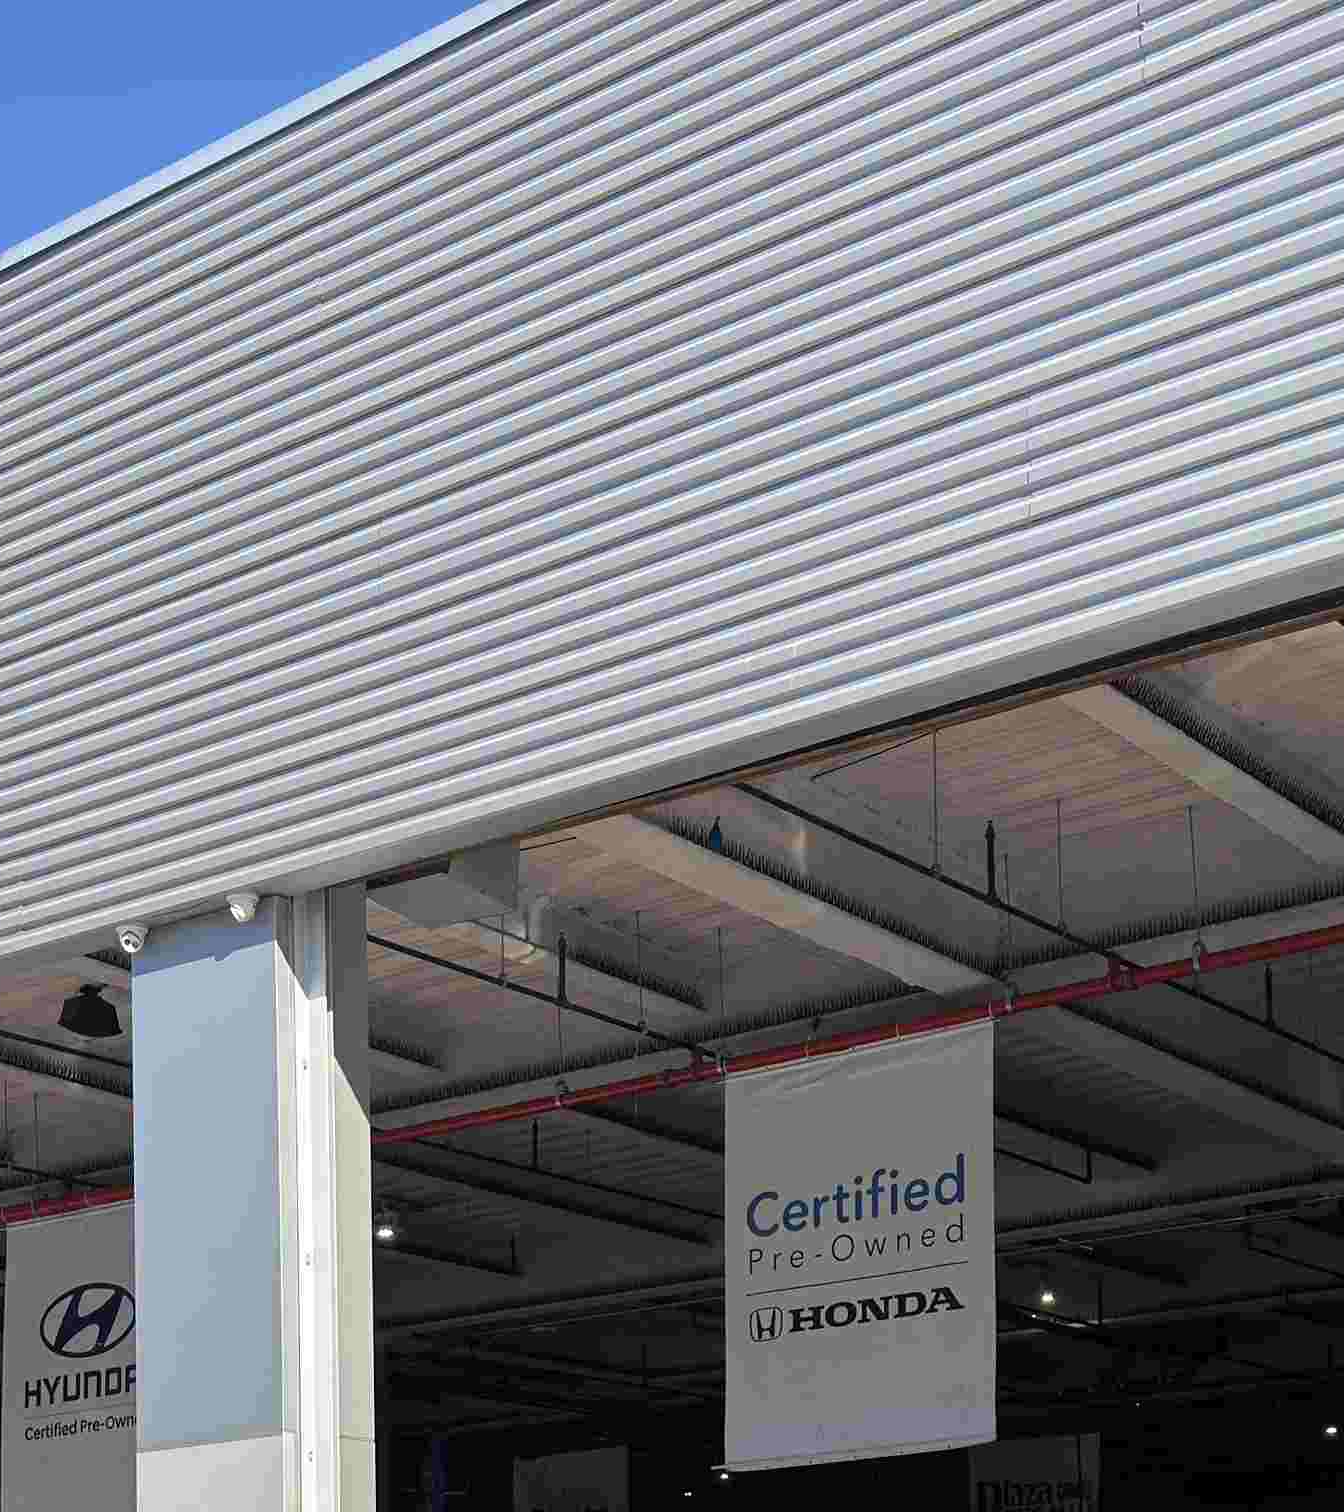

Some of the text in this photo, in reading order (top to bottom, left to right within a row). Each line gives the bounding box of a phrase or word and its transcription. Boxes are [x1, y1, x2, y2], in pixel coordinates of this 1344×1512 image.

[746, 1152, 966, 1238] Certified
[748, 1213, 965, 1275] Pre-Owned
[788, 1286, 966, 1334] HONDA
[24, 1363, 136, 1409] HYUNDA
[24, 1414, 136, 1441] Certified Pre-Own
